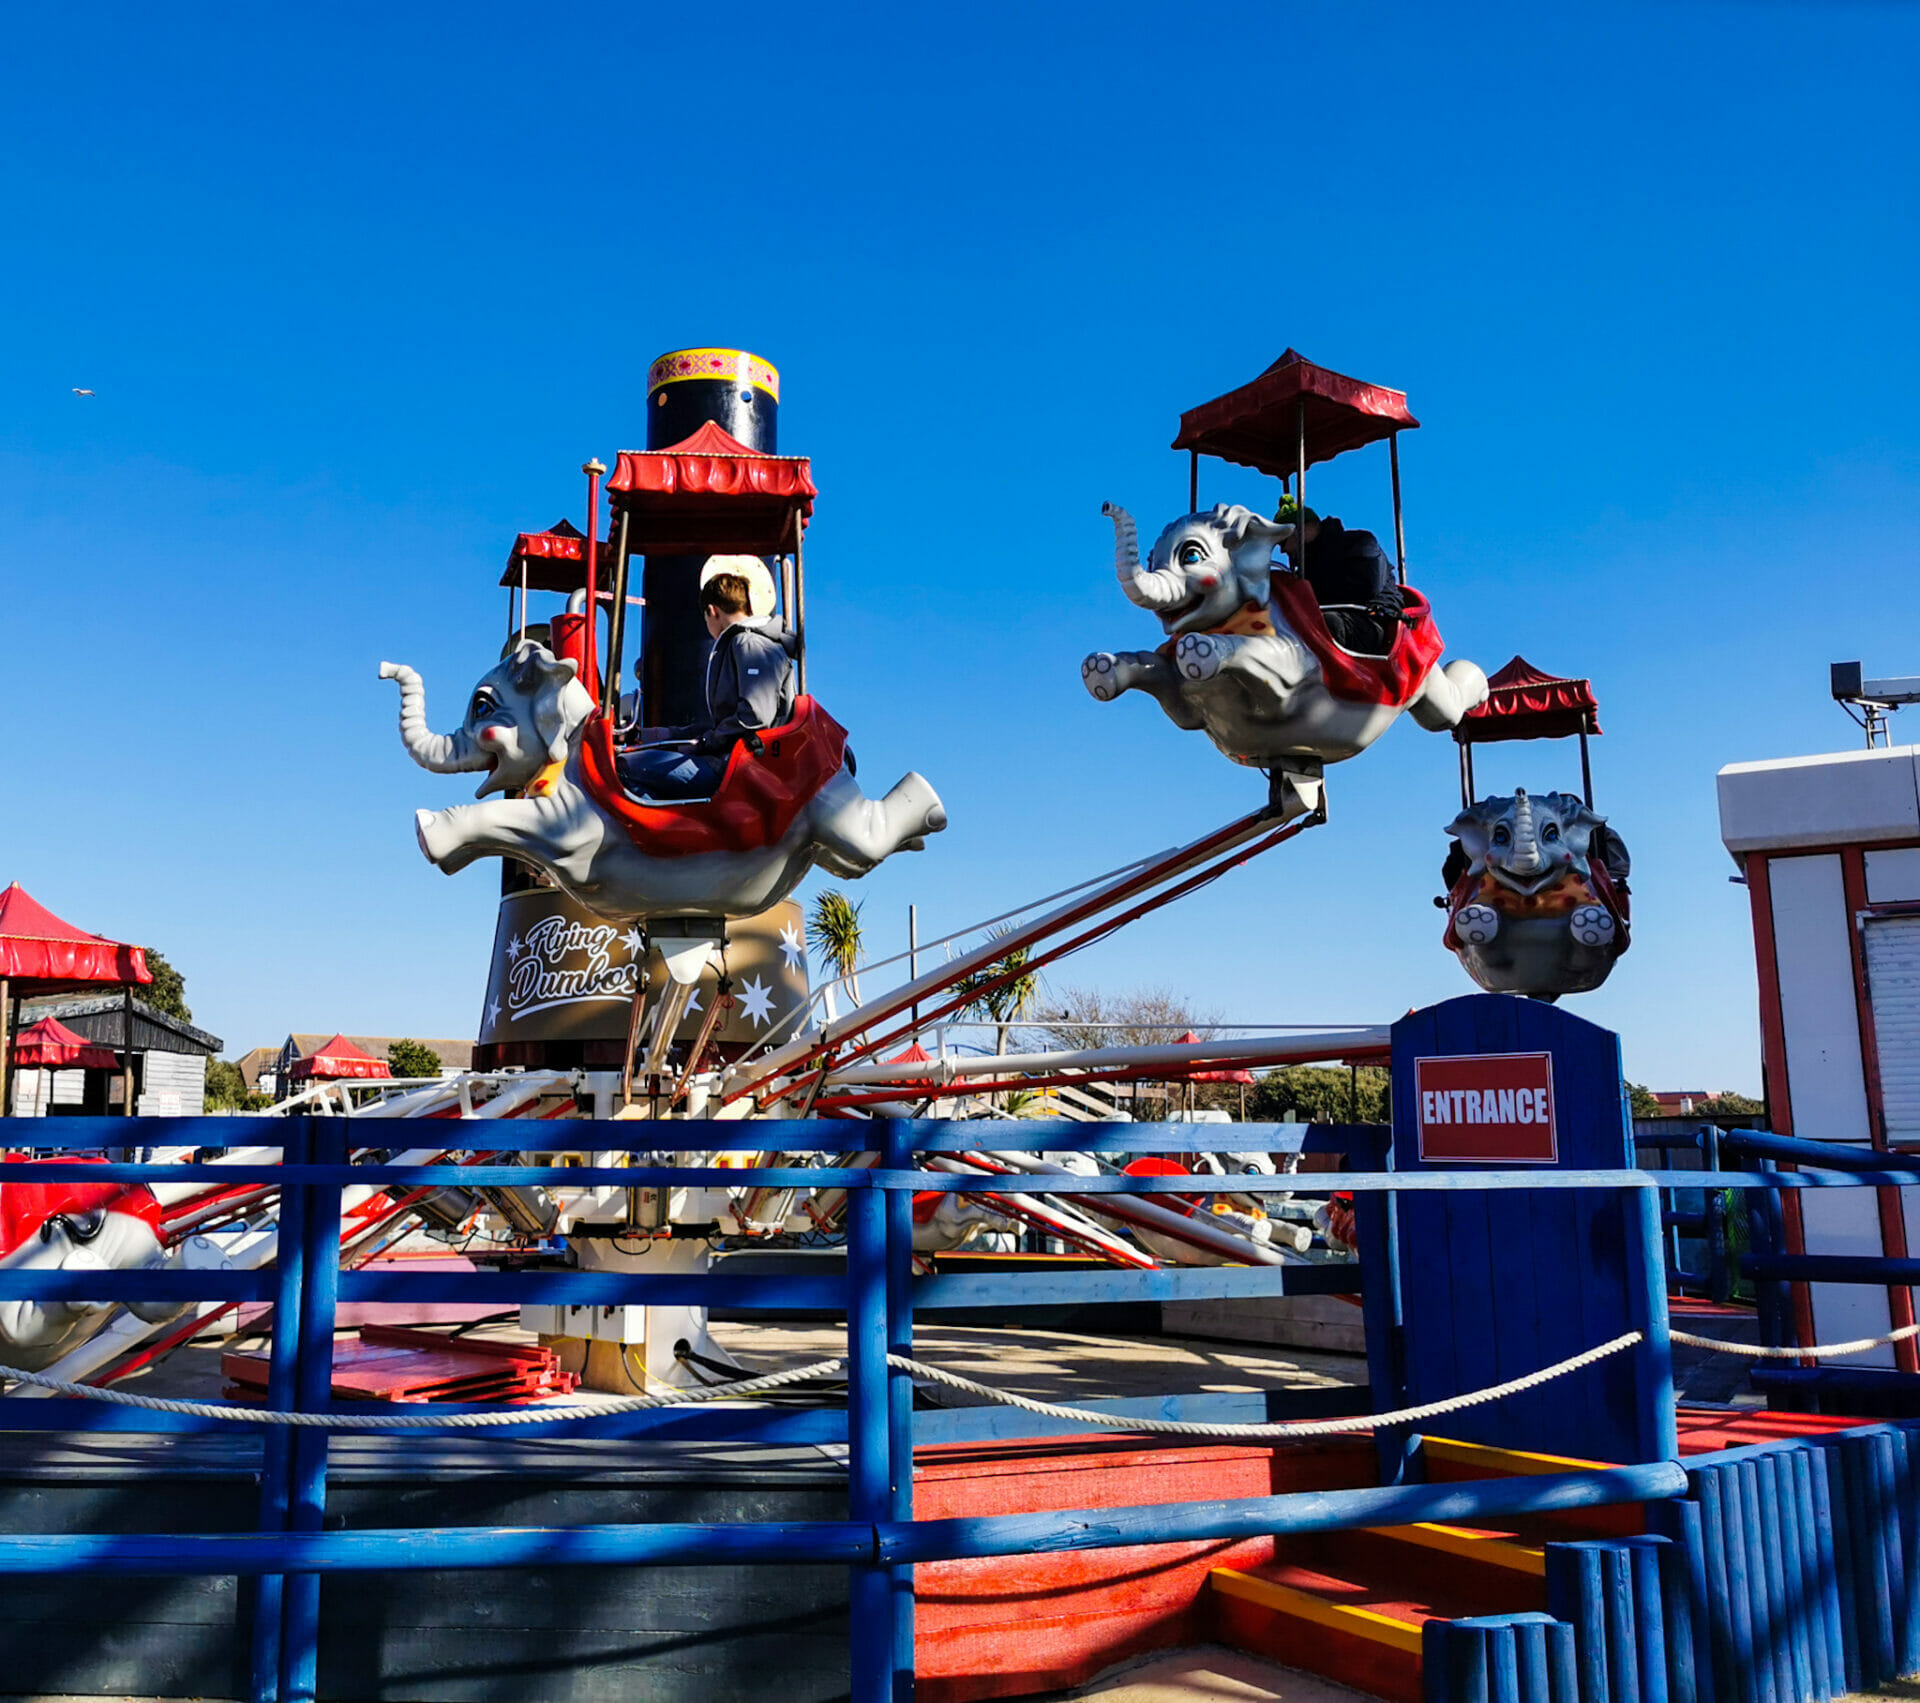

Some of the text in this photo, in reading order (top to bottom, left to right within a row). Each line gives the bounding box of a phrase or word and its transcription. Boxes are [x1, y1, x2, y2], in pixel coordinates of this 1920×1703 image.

[771, 740, 781, 757] 9
[526, 915, 618, 963] Flying
[508, 952, 650, 1009] Dumbos
[1422, 1088, 1549, 1124] ENTRANCE
